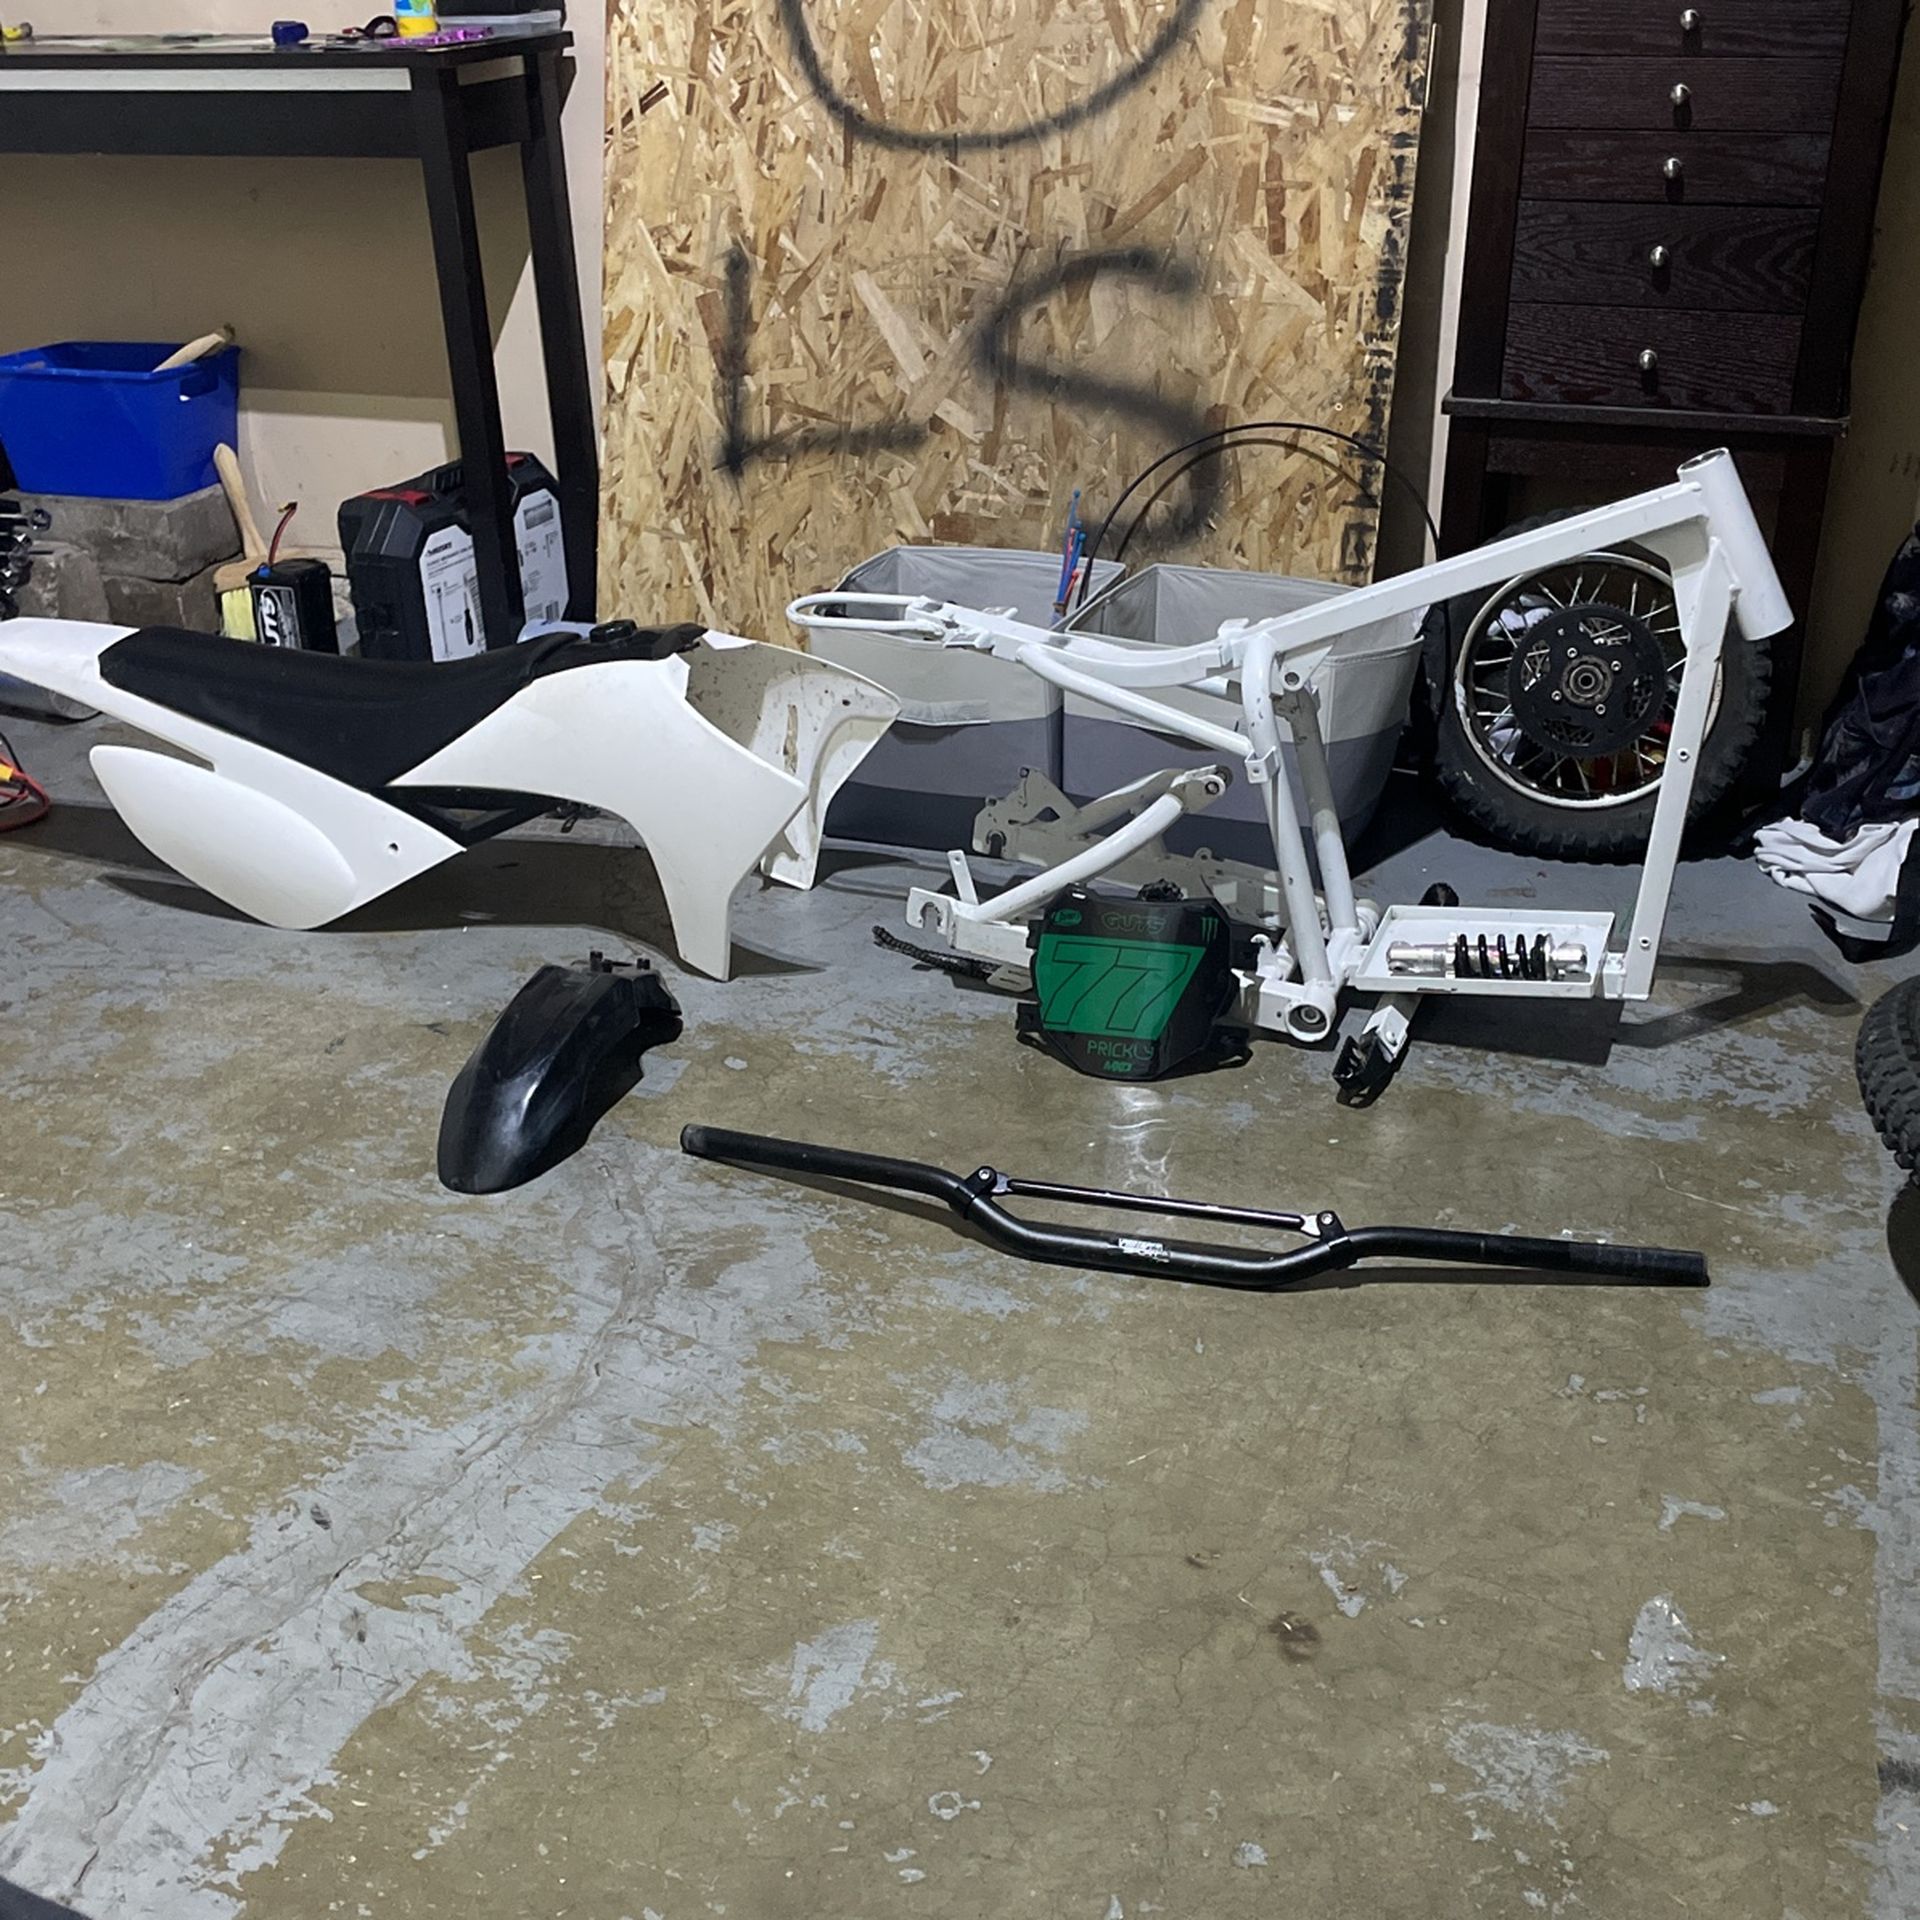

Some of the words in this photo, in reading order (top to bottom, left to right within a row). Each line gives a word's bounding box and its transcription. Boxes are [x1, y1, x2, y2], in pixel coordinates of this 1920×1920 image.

[1101, 911, 1166, 934] GUTS
[1043, 942, 1190, 1032] 77
[1087, 1039, 1154, 1061] PRICKLY
